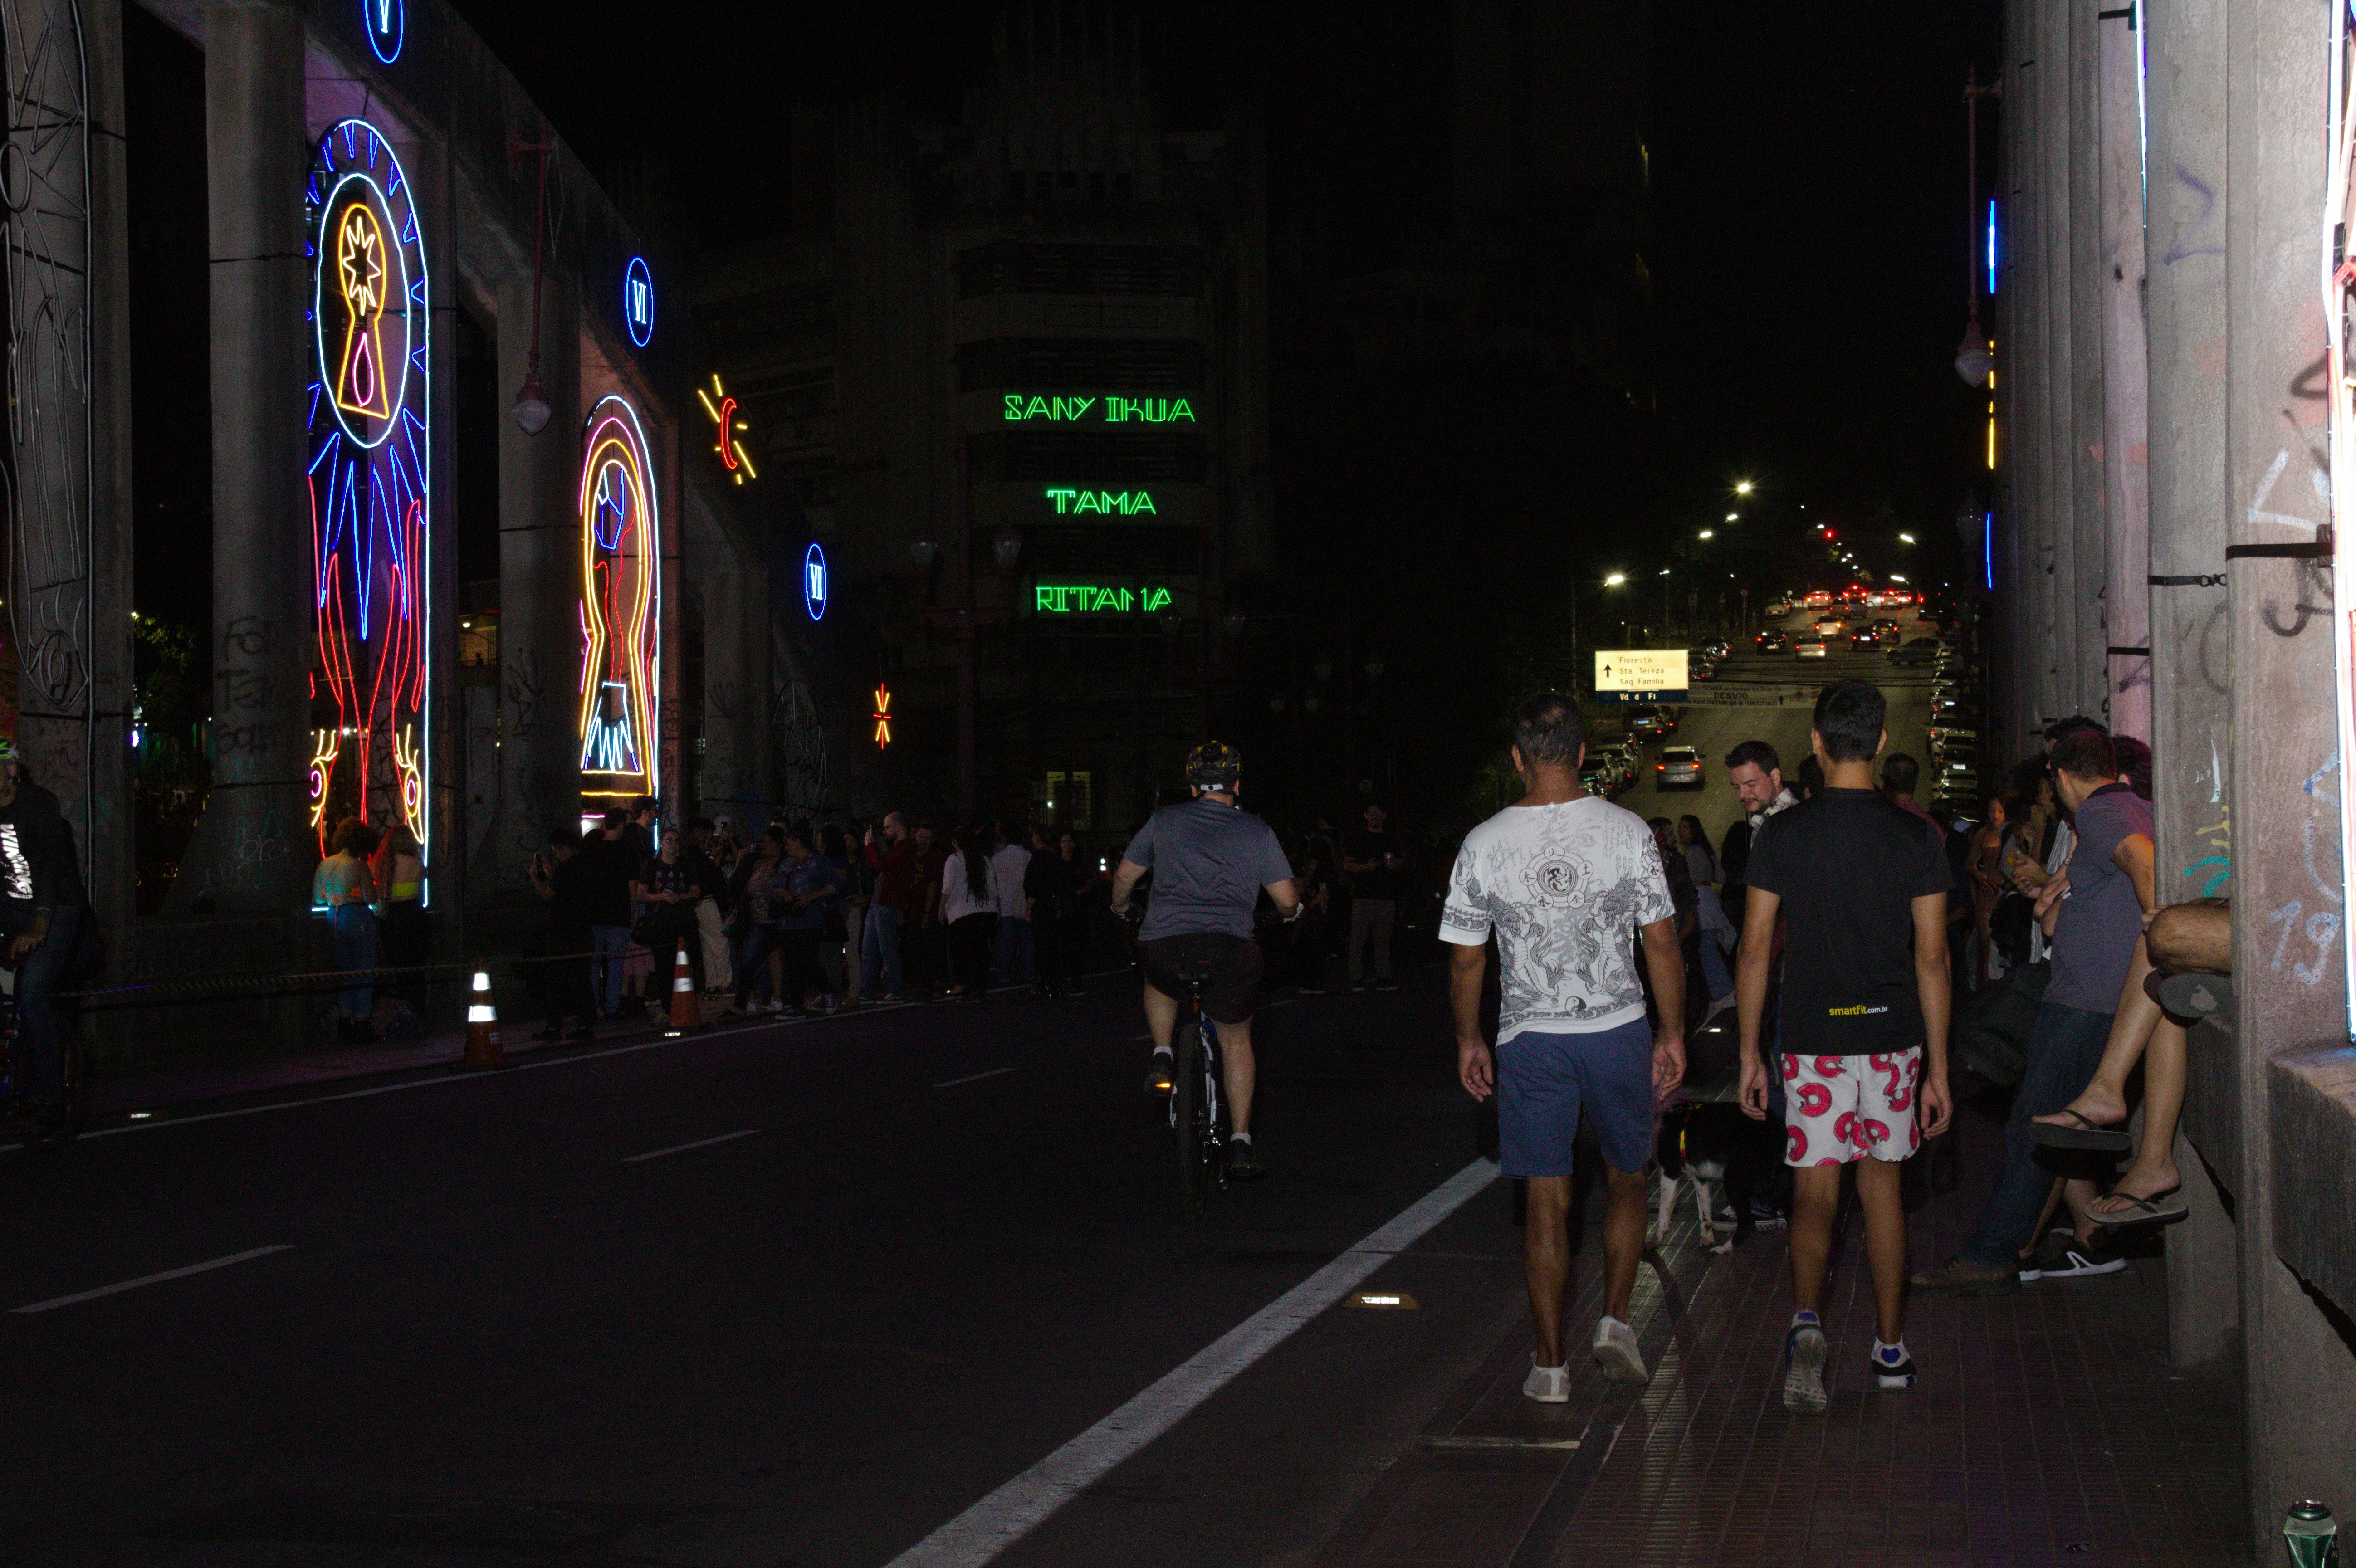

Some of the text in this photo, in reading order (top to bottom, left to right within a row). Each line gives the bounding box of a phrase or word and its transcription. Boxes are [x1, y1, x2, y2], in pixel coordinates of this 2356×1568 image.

[632, 280, 647, 324] VI
[1005, 396, 1195, 422] SANY IKUA
[1047, 490, 1156, 515] TAMA
[809, 563, 823, 600] VII
[1828, 1005, 1888, 1016] smartfit.com.br
